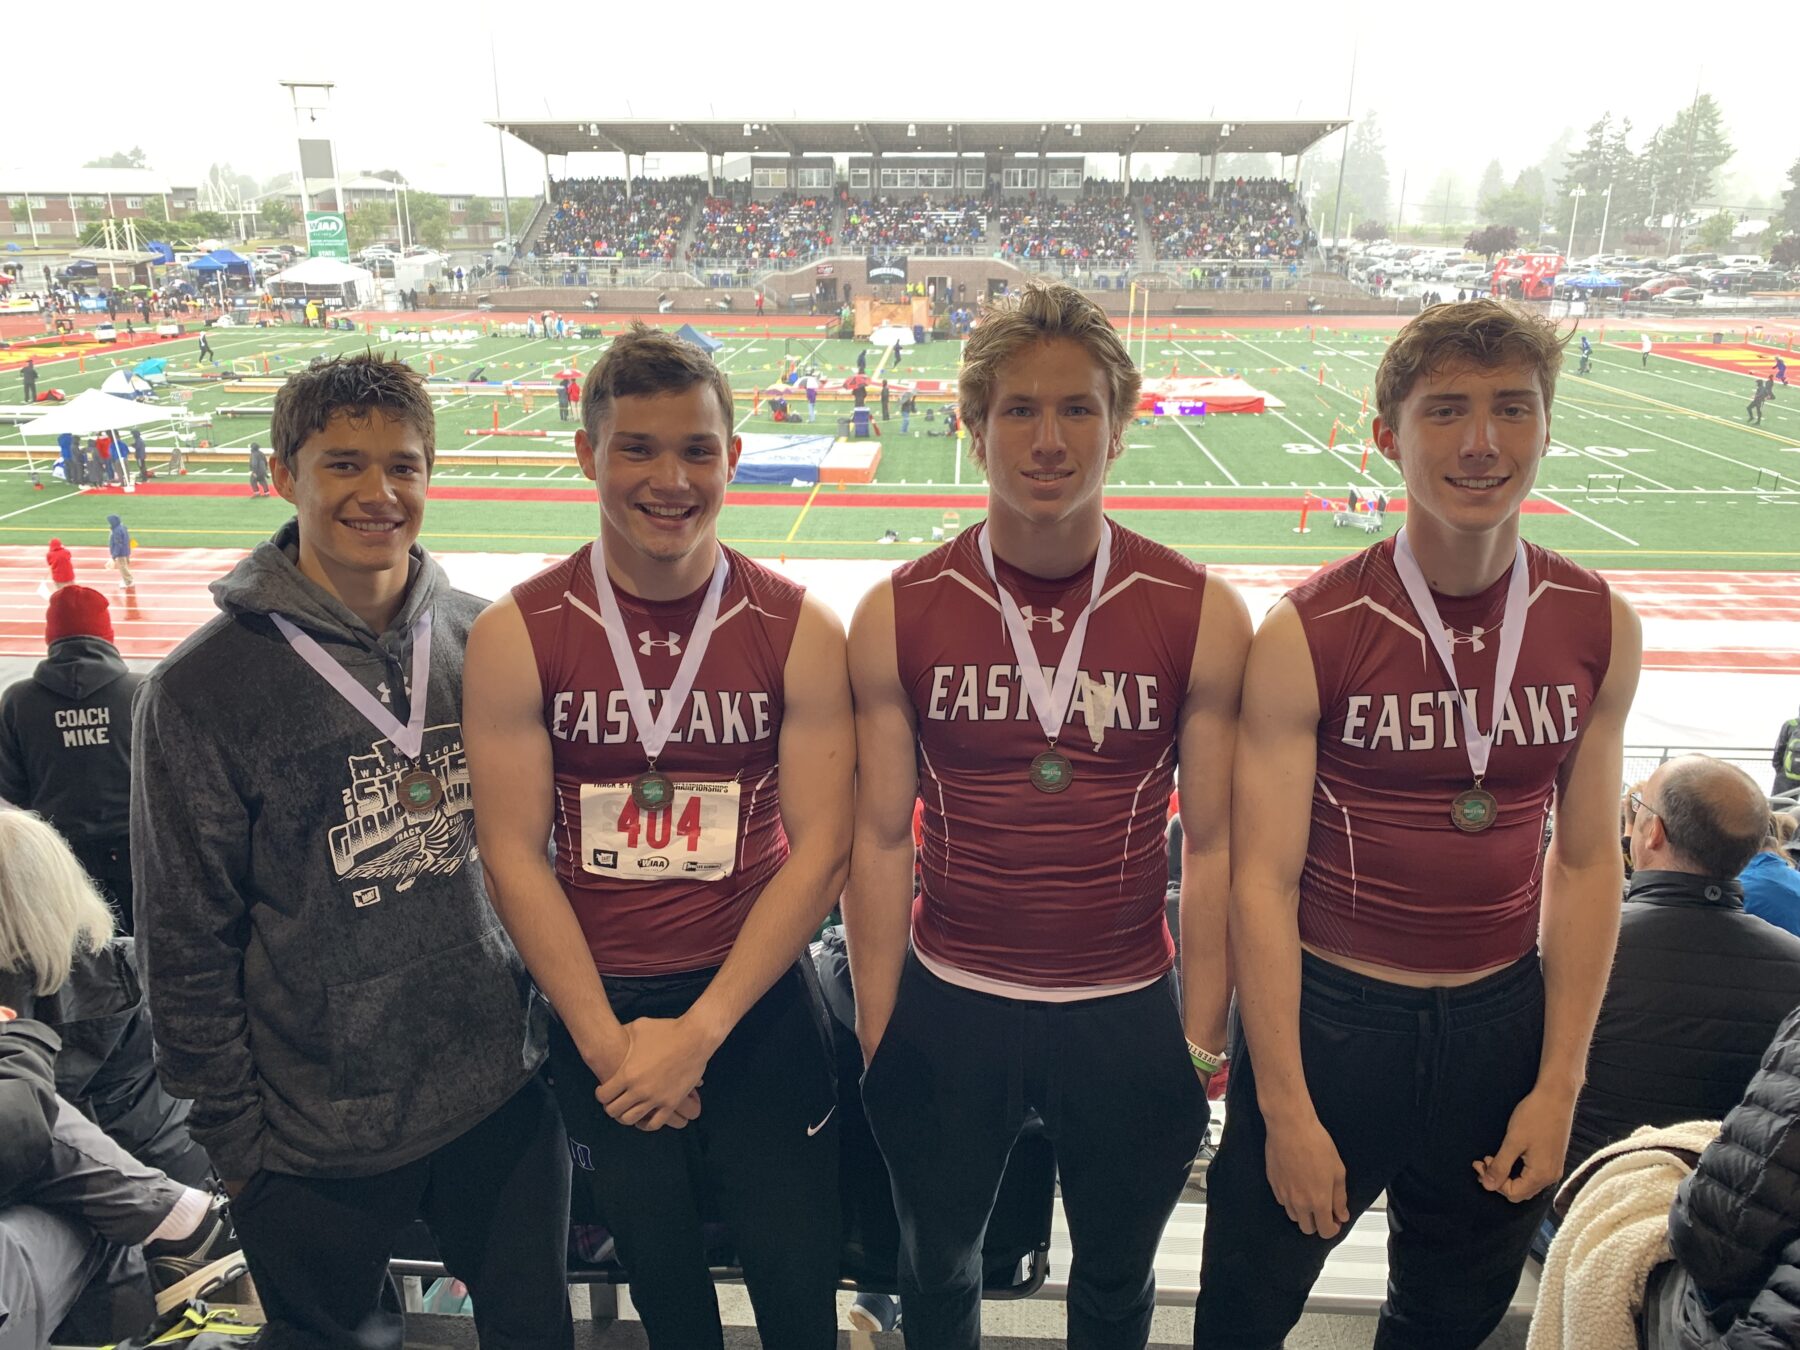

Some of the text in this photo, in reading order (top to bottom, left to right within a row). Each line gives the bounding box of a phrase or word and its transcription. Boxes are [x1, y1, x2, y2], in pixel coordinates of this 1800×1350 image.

[927, 664, 1160, 731] EASTAKE
[54, 707, 110, 728] COACH
[62, 727, 110, 747] MIKE
[395, 826, 422, 844] TRACK
